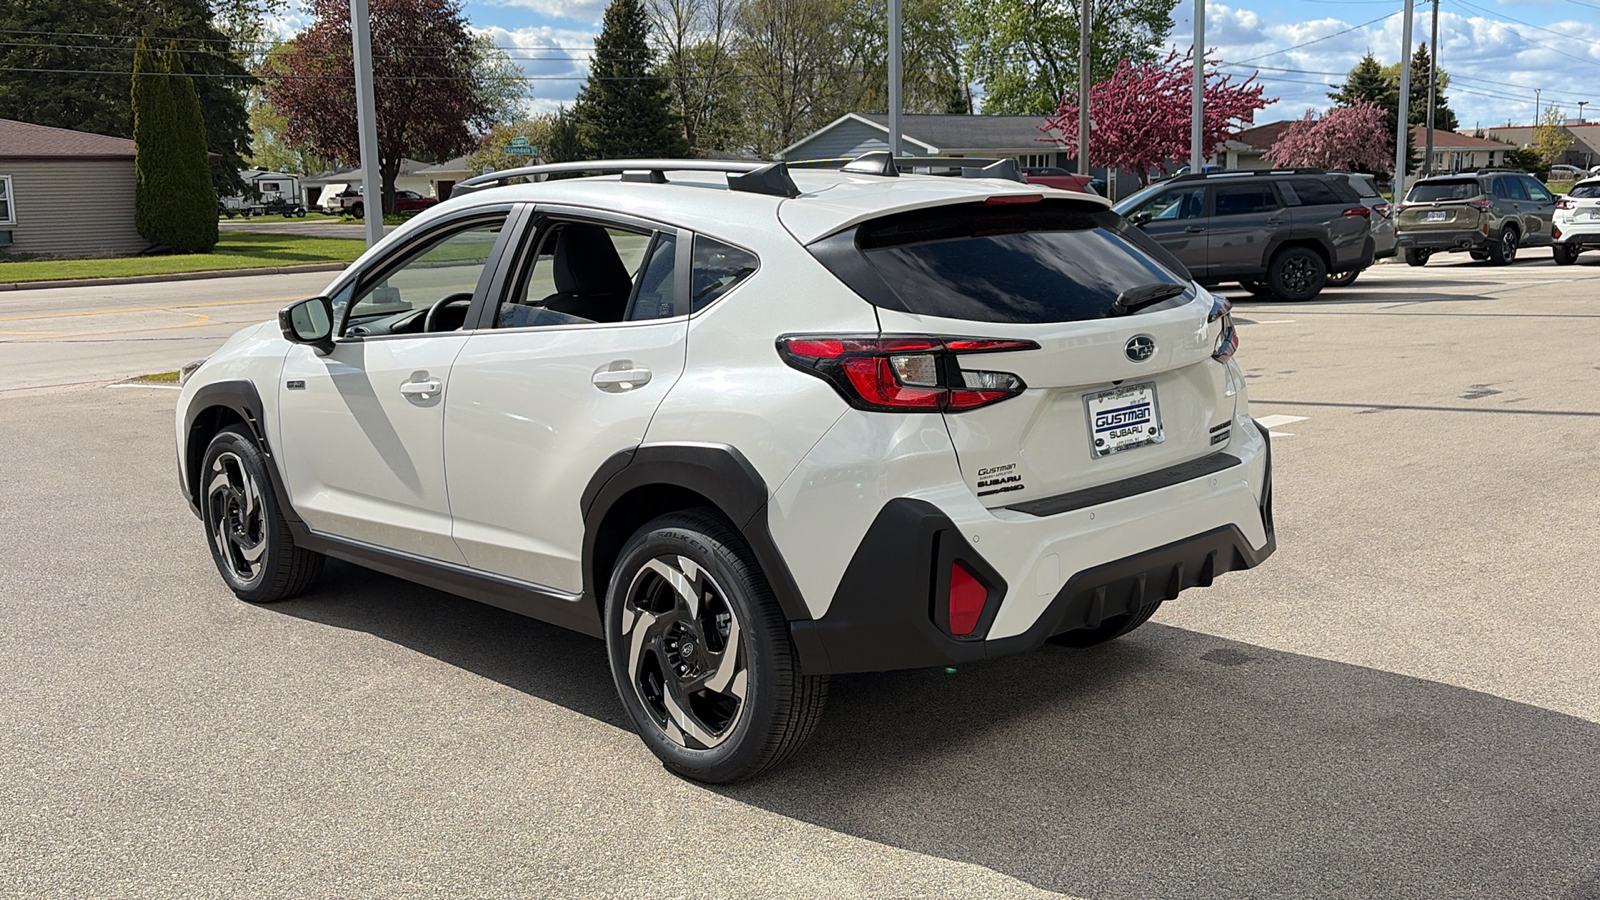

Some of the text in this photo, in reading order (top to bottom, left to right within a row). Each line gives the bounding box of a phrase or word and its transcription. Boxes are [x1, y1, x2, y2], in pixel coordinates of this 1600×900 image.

[1095, 407, 1151, 428] GUSTman
[1109, 425, 1143, 439] SUBARU
[978, 463, 1016, 476] GUSTman
[977, 475, 1021, 488] SUBARU
[656, 531, 709, 555] FALKEN
